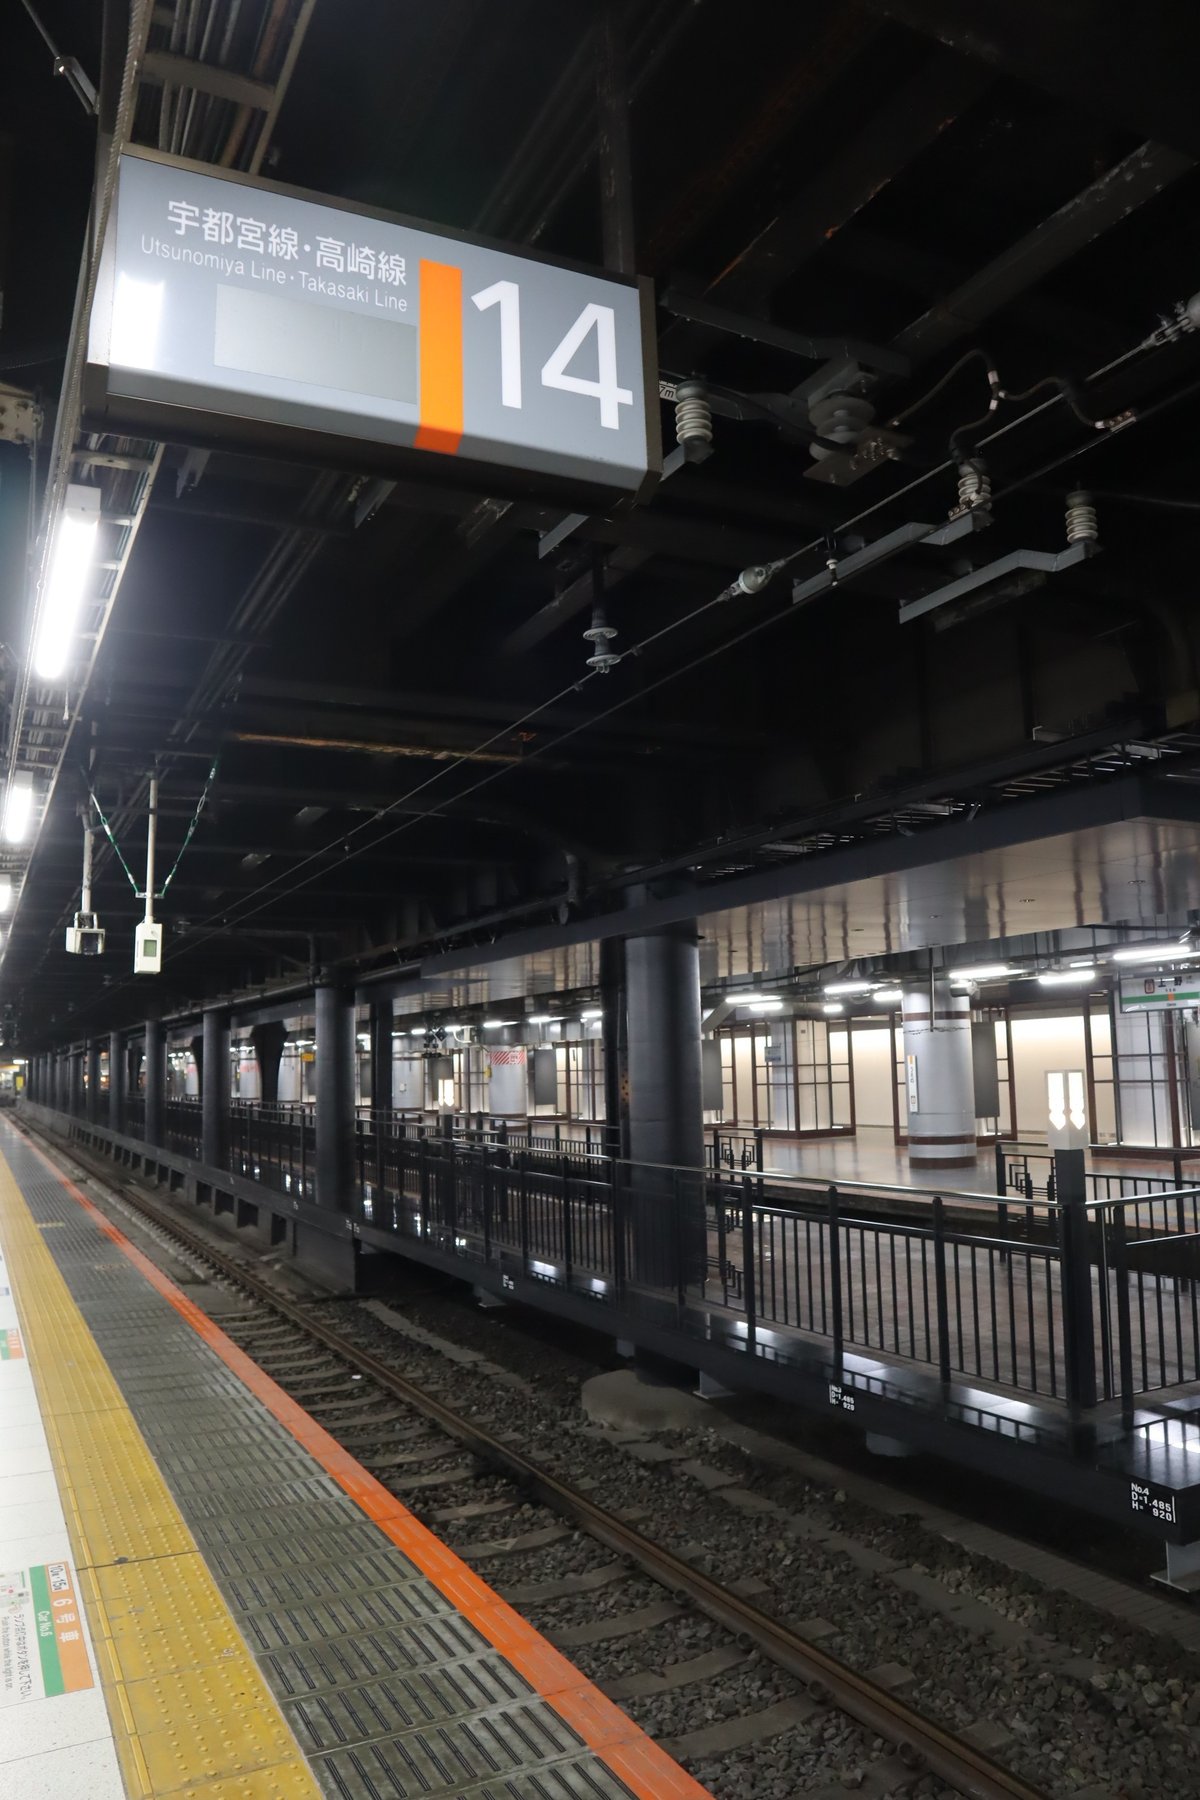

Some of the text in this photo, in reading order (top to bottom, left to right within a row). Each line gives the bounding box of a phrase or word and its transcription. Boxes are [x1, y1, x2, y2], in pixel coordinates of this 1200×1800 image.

[141, 234, 245, 276] Utsunomiya
[251, 260, 286, 284] Line
[298, 270, 369, 304] Takasaki
[375, 288, 408, 312] Line
[167, 201, 407, 286] 宇都宮線・高崎線
[471, 280, 633, 430] 14
